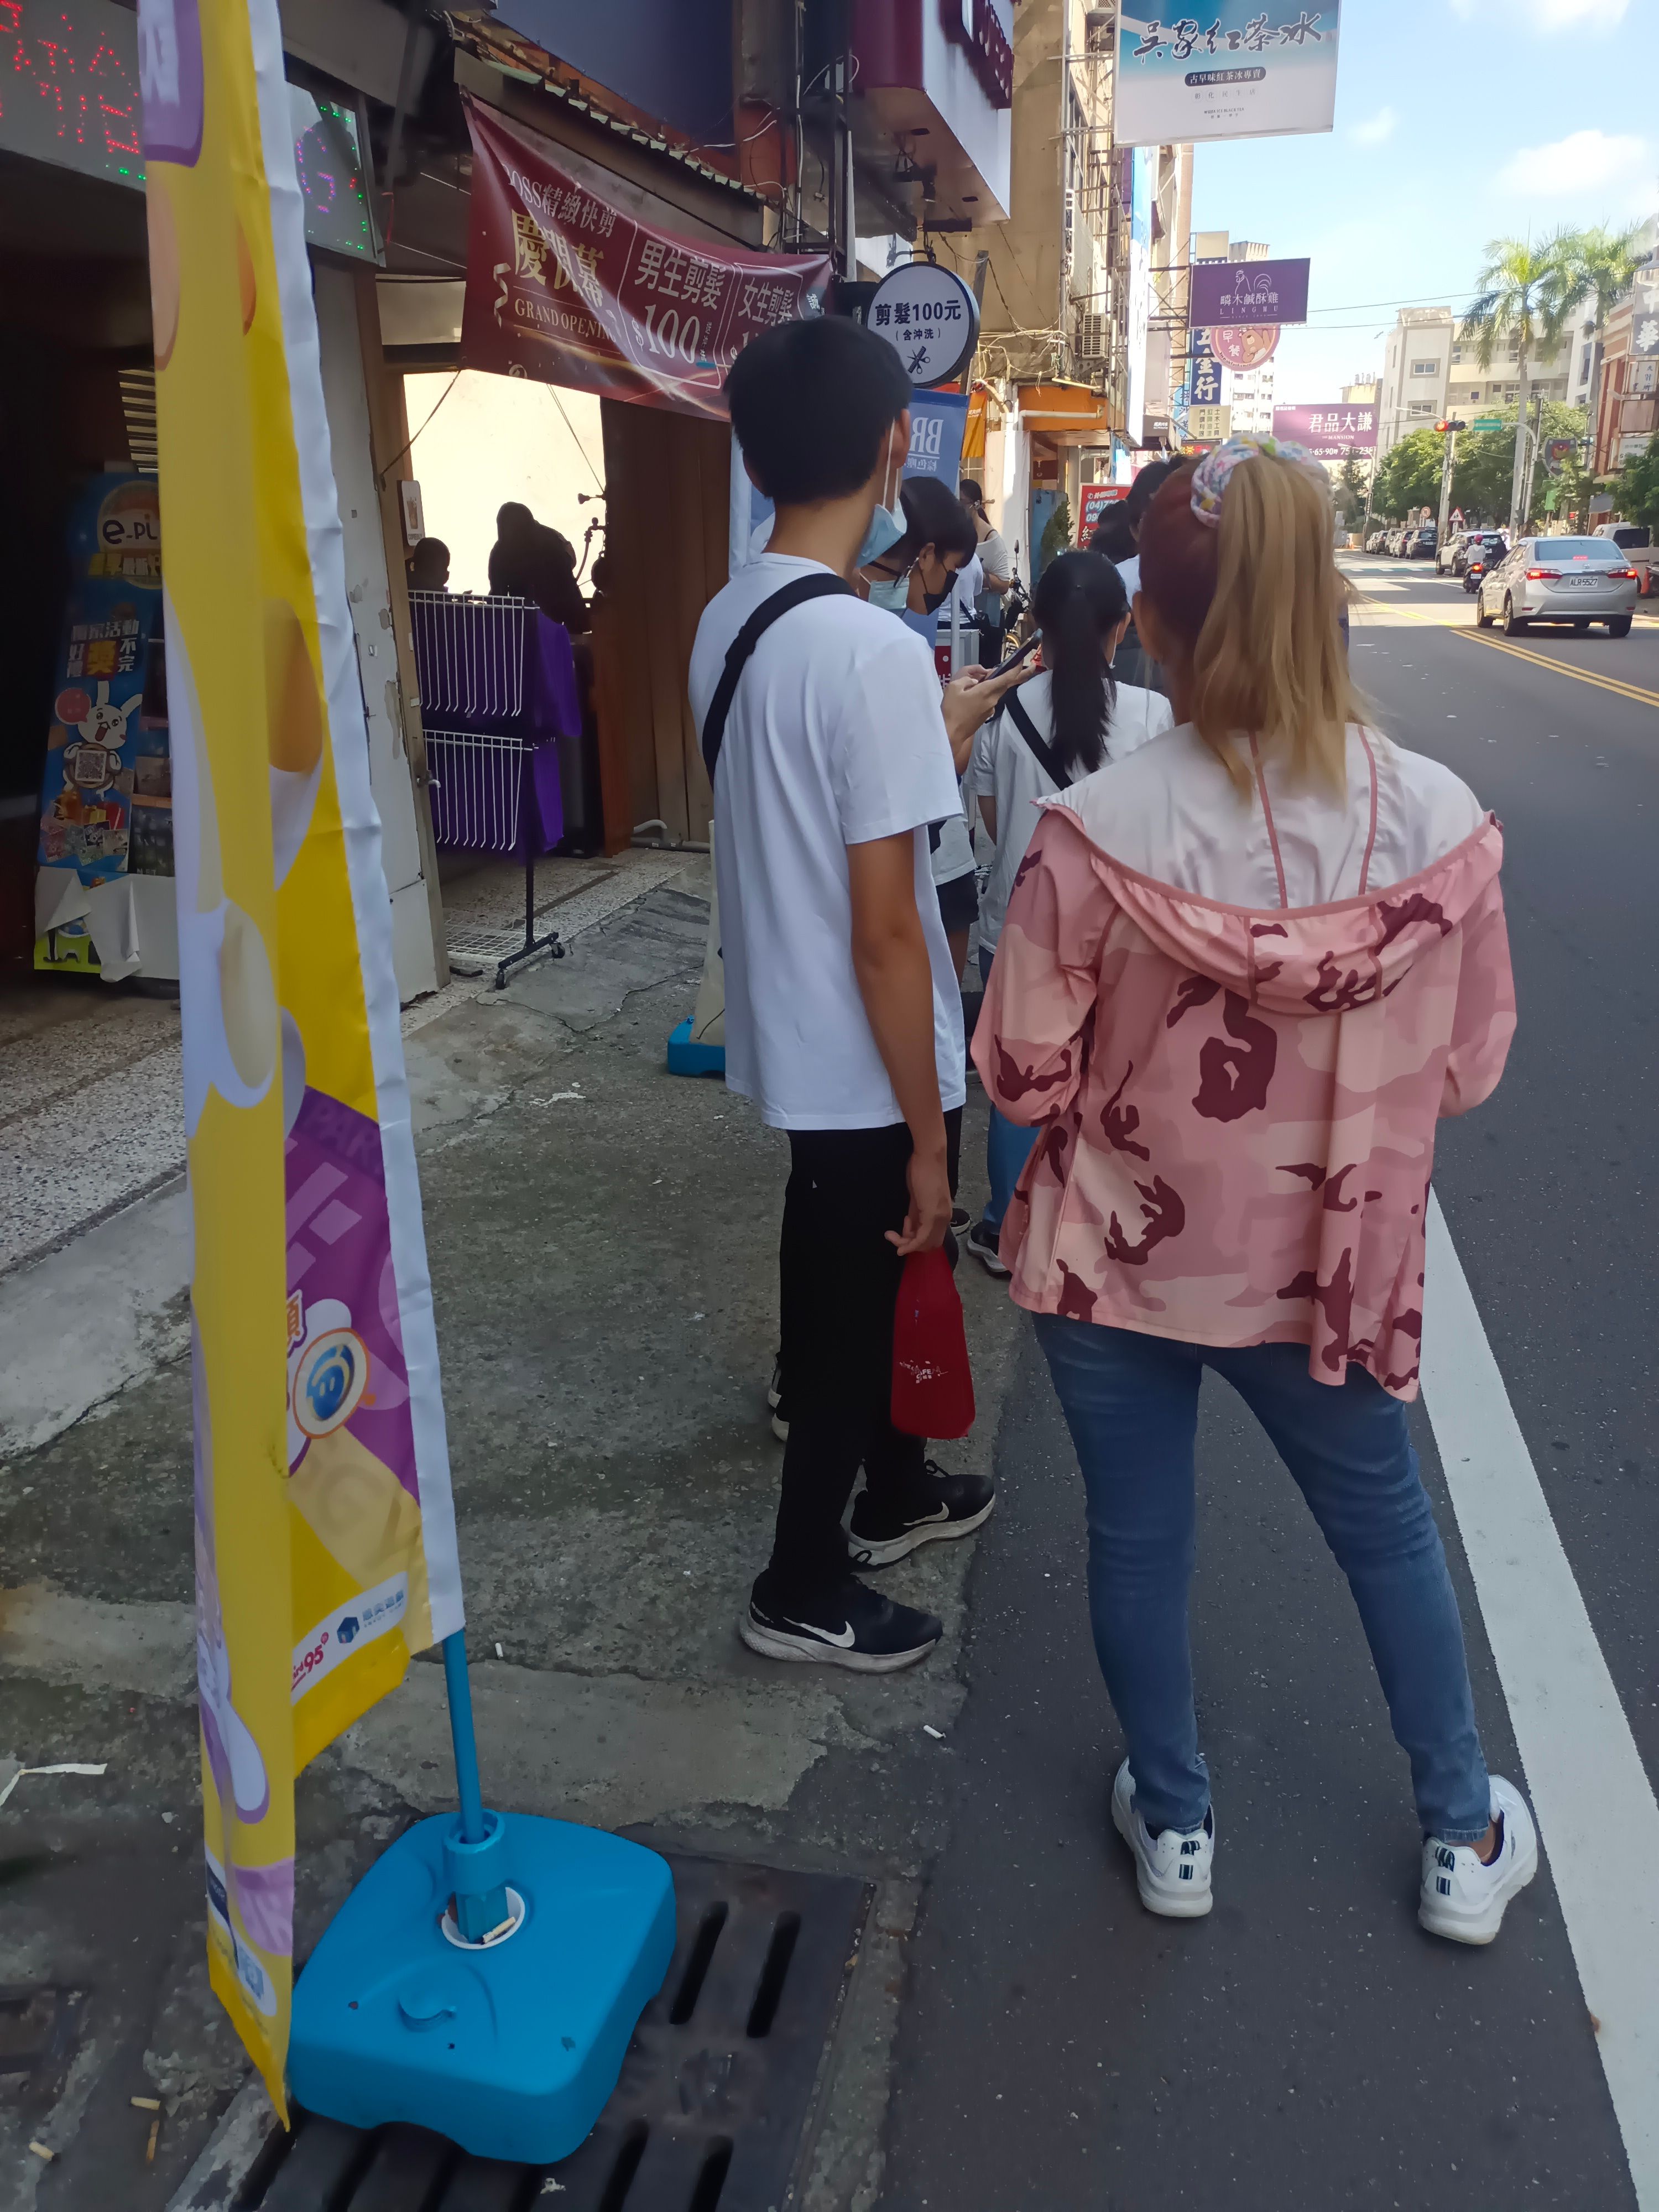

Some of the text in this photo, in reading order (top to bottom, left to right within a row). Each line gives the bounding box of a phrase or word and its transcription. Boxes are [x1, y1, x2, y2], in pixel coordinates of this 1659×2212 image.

[634, 239, 726, 310] 男生剪髮
[515, 298, 559, 326] GRAND
[875, 299, 962, 326] 剪髮100元
[1223, 330, 1240, 357] 早餐
[1308, 411, 1373, 433] 君品大謙
[1086, 513, 1100, 522] 09
